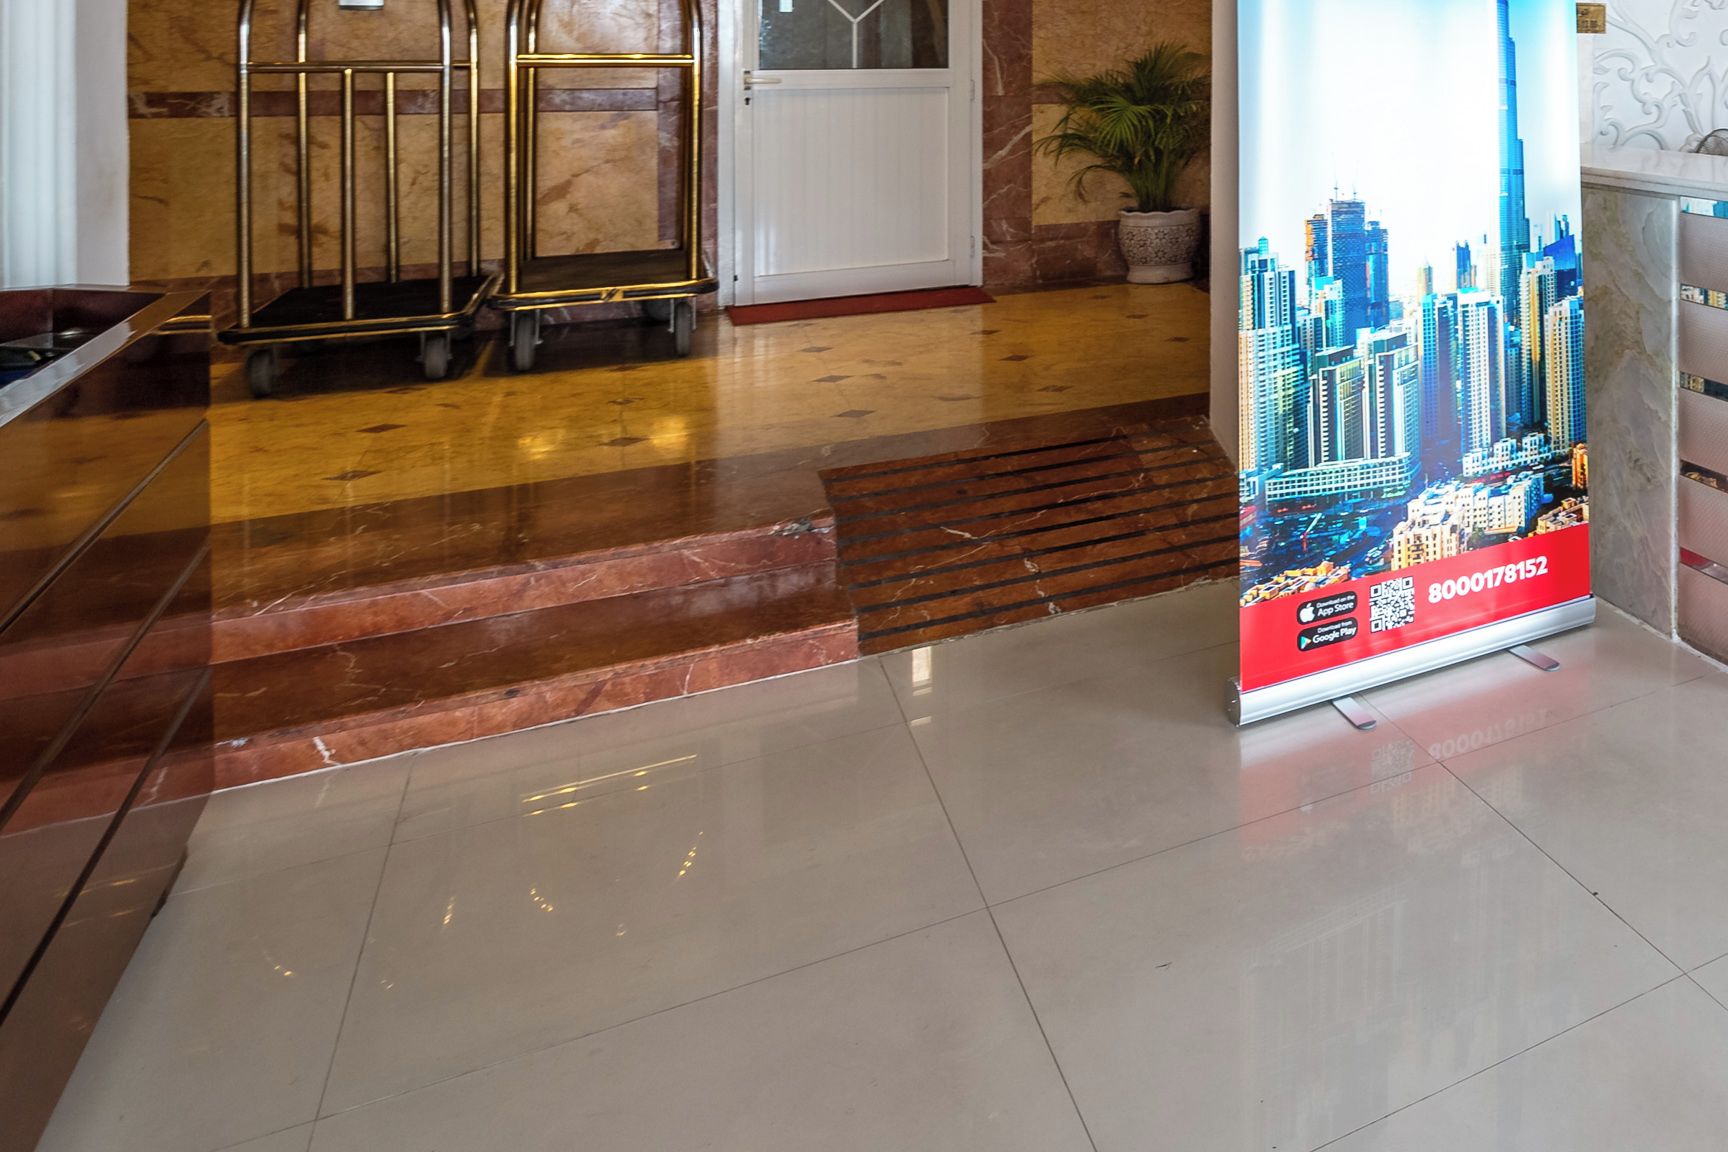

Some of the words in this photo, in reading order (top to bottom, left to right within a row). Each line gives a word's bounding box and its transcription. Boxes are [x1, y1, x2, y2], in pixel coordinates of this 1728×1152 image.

[1428, 555, 1548, 603] 8000178152
[1317, 607, 1334, 617] App
[1334, 602, 1354, 613] Store
[1312, 630, 1340, 644] Google
[1340, 627, 1357, 636] Play
